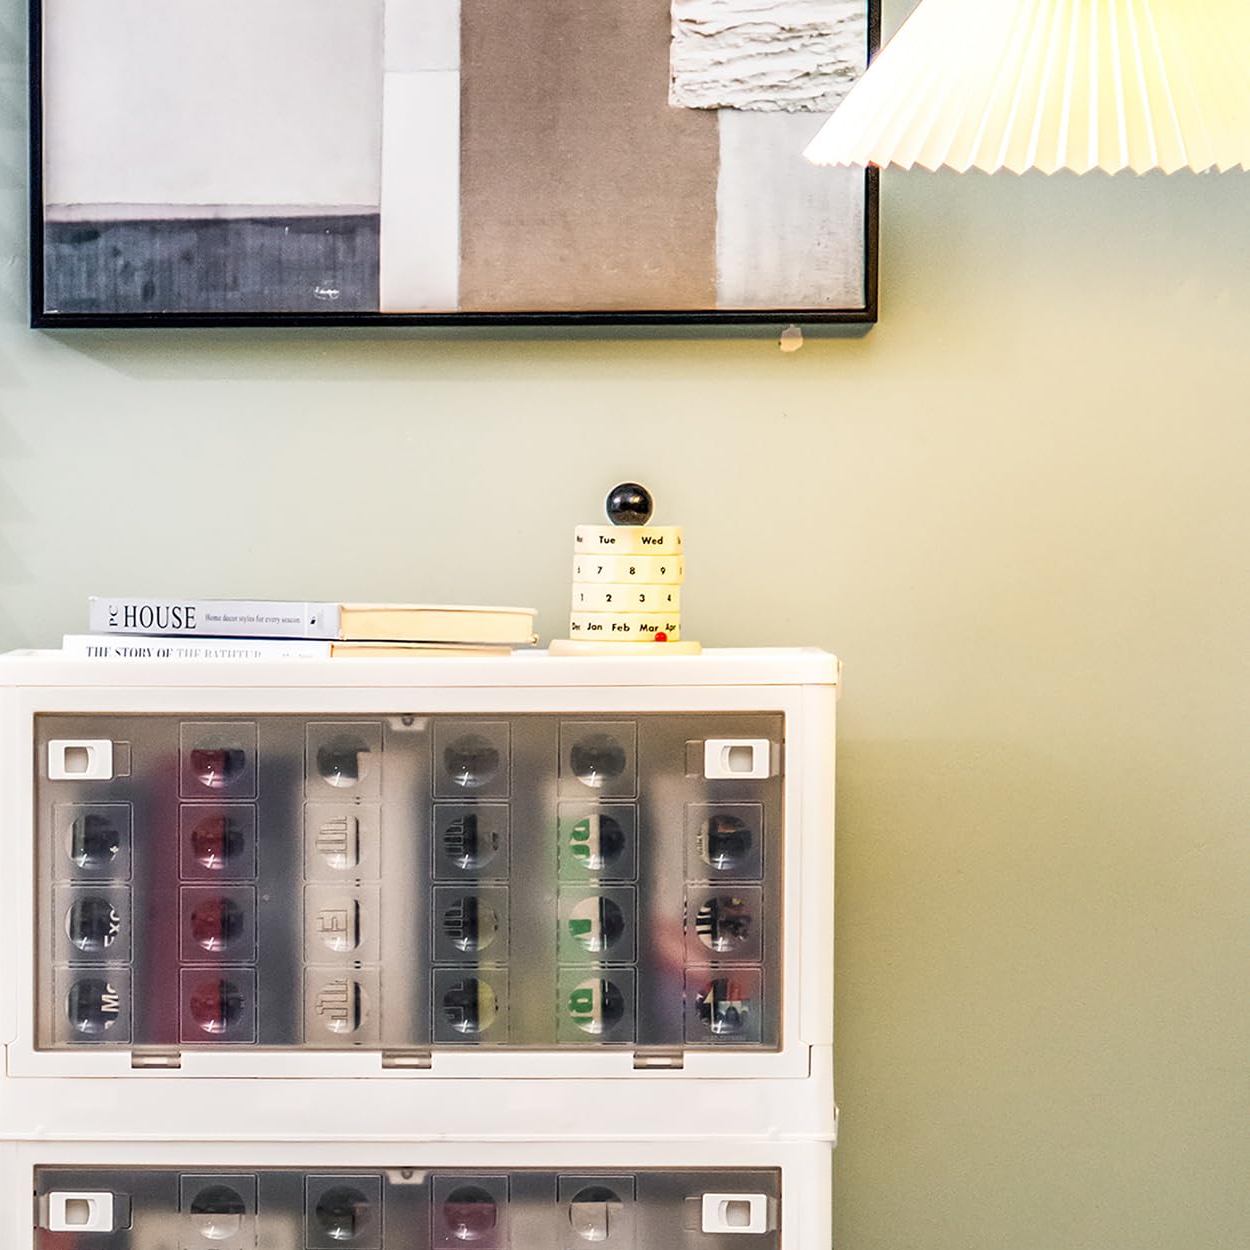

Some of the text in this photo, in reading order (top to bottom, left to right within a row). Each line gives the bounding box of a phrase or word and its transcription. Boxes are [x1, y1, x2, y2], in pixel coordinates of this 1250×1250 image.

[598, 535, 664, 545] Tue Wed
[597, 566, 603, 575] 7
[629, 566, 636, 576] 8
[660, 566, 667, 576] 9
[605, 593, 612, 603] 2
[639, 593, 646, 603] 3
[666, 594, 672, 602] 4
[123, 605, 197, 630] HOUSE
[586, 622, 603, 631] Jan
[611, 623, 631, 632] Feb
[639, 623, 659, 632] Mar
[113, 647, 155, 659] STORY
[157, 648, 174, 659] OF
